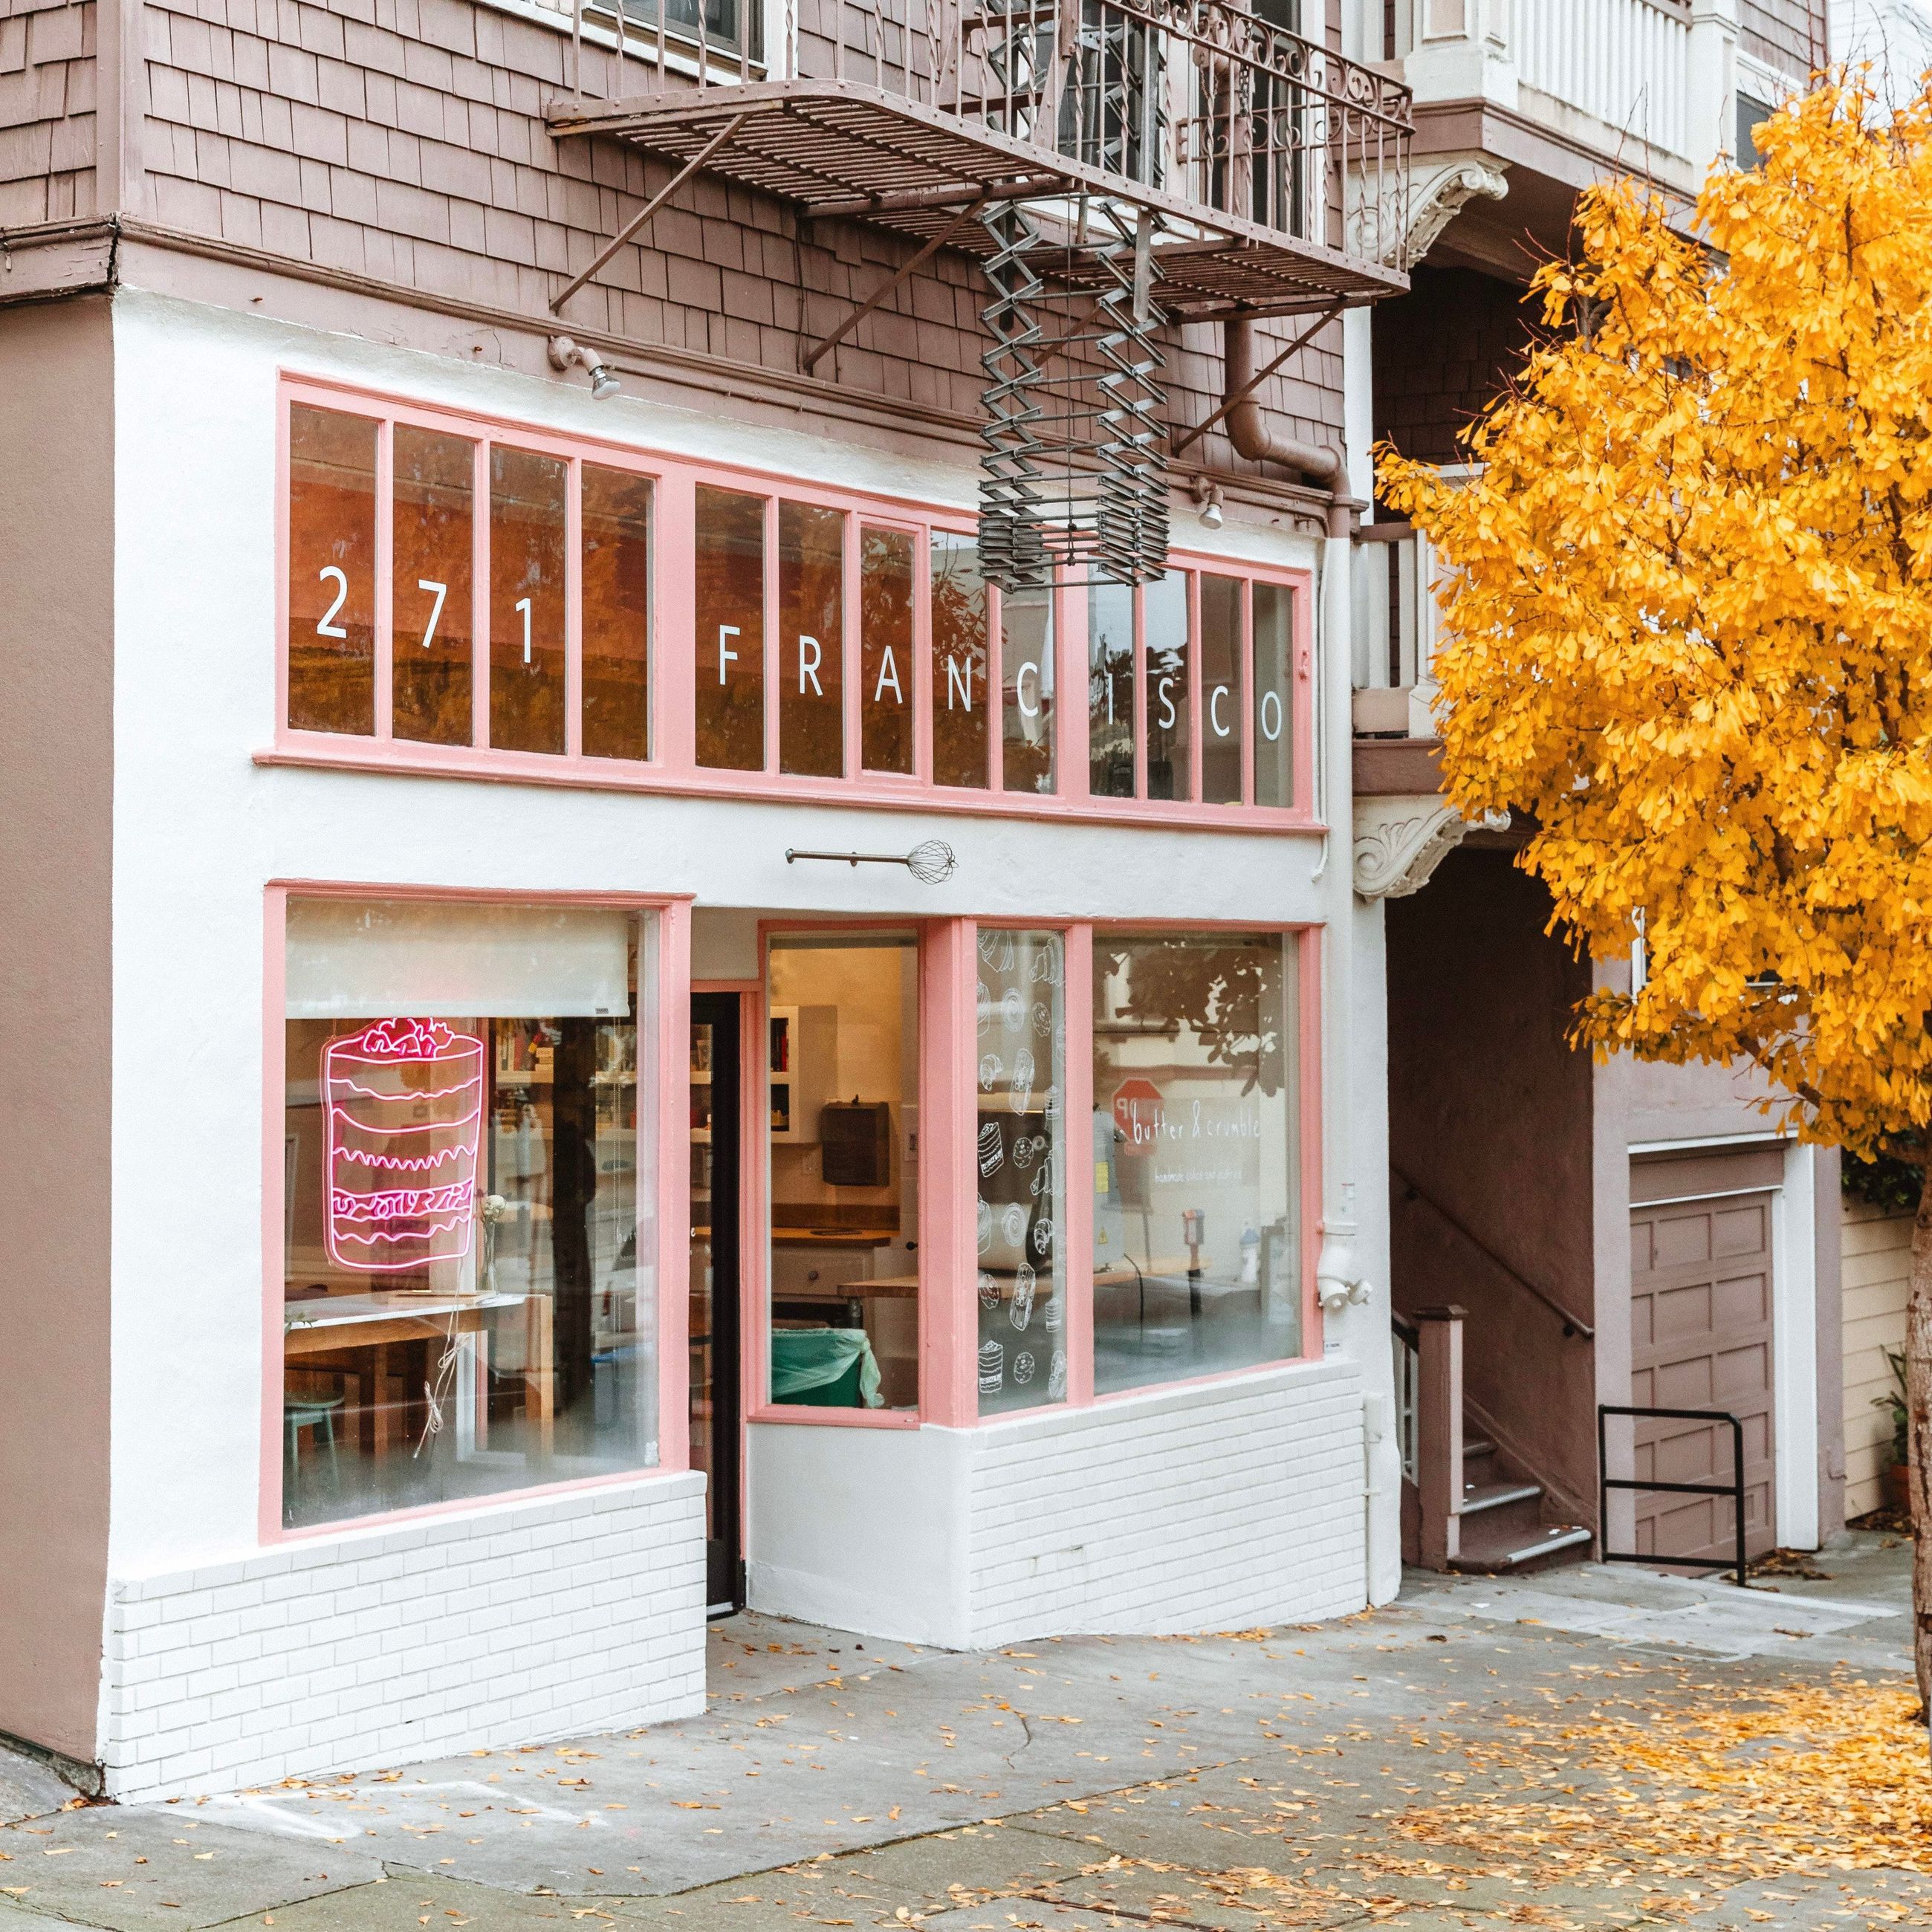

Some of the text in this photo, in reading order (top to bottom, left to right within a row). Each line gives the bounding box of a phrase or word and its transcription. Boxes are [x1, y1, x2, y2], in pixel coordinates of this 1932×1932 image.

[317, 565, 1282, 742] 271 FRANCISCO
[1133, 1100, 1261, 1144] butter & crumble
